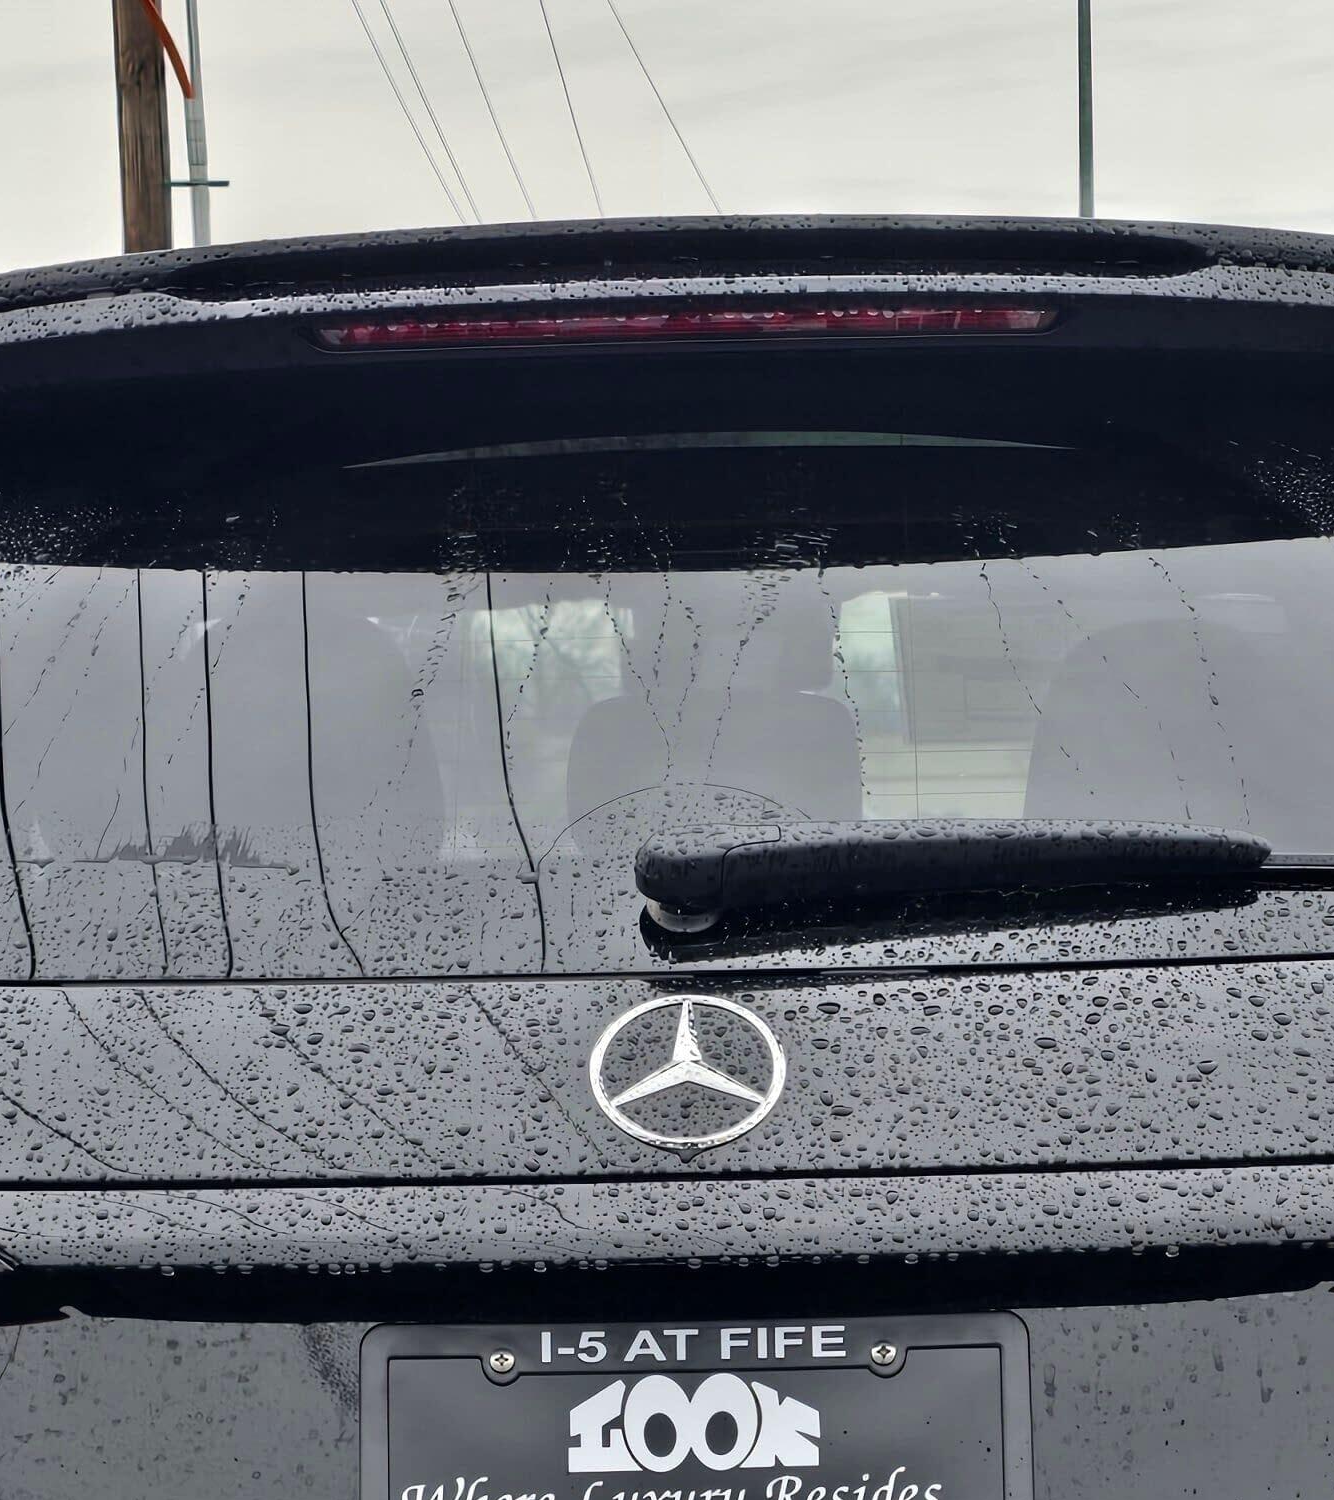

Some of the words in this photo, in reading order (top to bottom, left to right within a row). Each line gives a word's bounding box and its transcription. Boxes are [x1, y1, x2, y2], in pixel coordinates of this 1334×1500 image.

[540, 1330, 608, 1364] I-5
[623, 1328, 699, 1362] AT
[718, 1324, 847, 1361] FIFE
